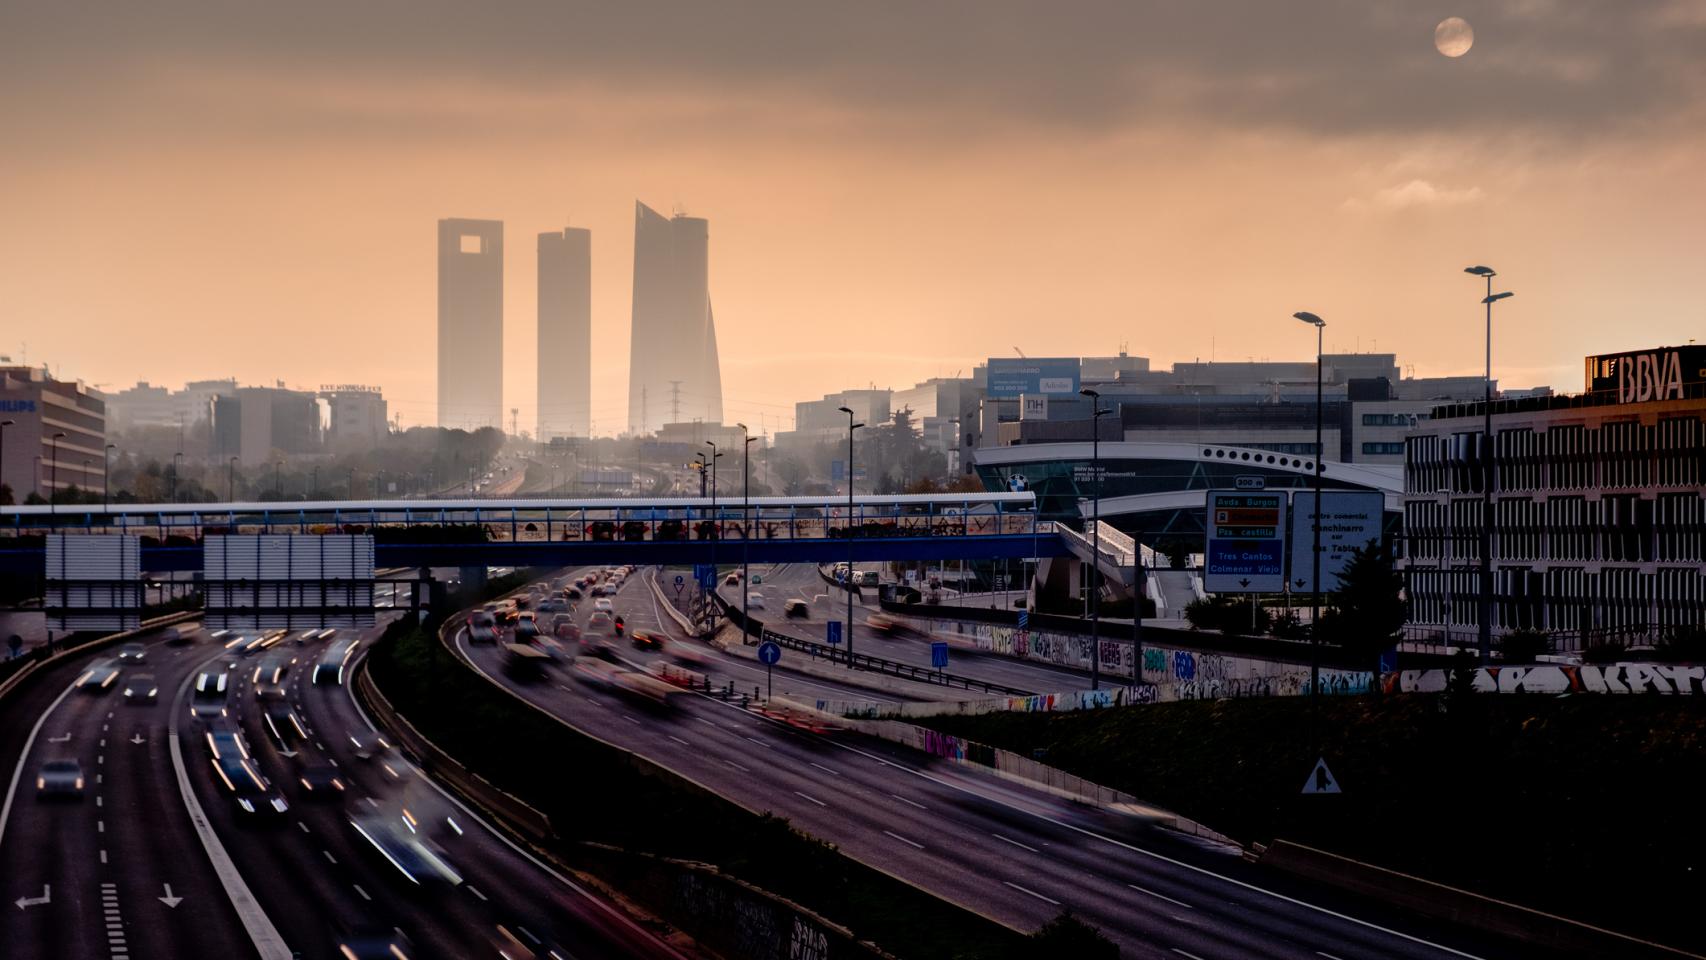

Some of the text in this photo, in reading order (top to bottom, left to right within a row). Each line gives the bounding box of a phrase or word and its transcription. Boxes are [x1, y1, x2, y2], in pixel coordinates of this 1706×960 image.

[1619, 352, 1684, 404] BBVA
[0, 400, 37, 412] ILIPS
[1247, 498, 1277, 508] Burgos
[1217, 552, 1272, 560] Tres Cantos
[1210, 565, 1279, 574] Colmenar Viejo
